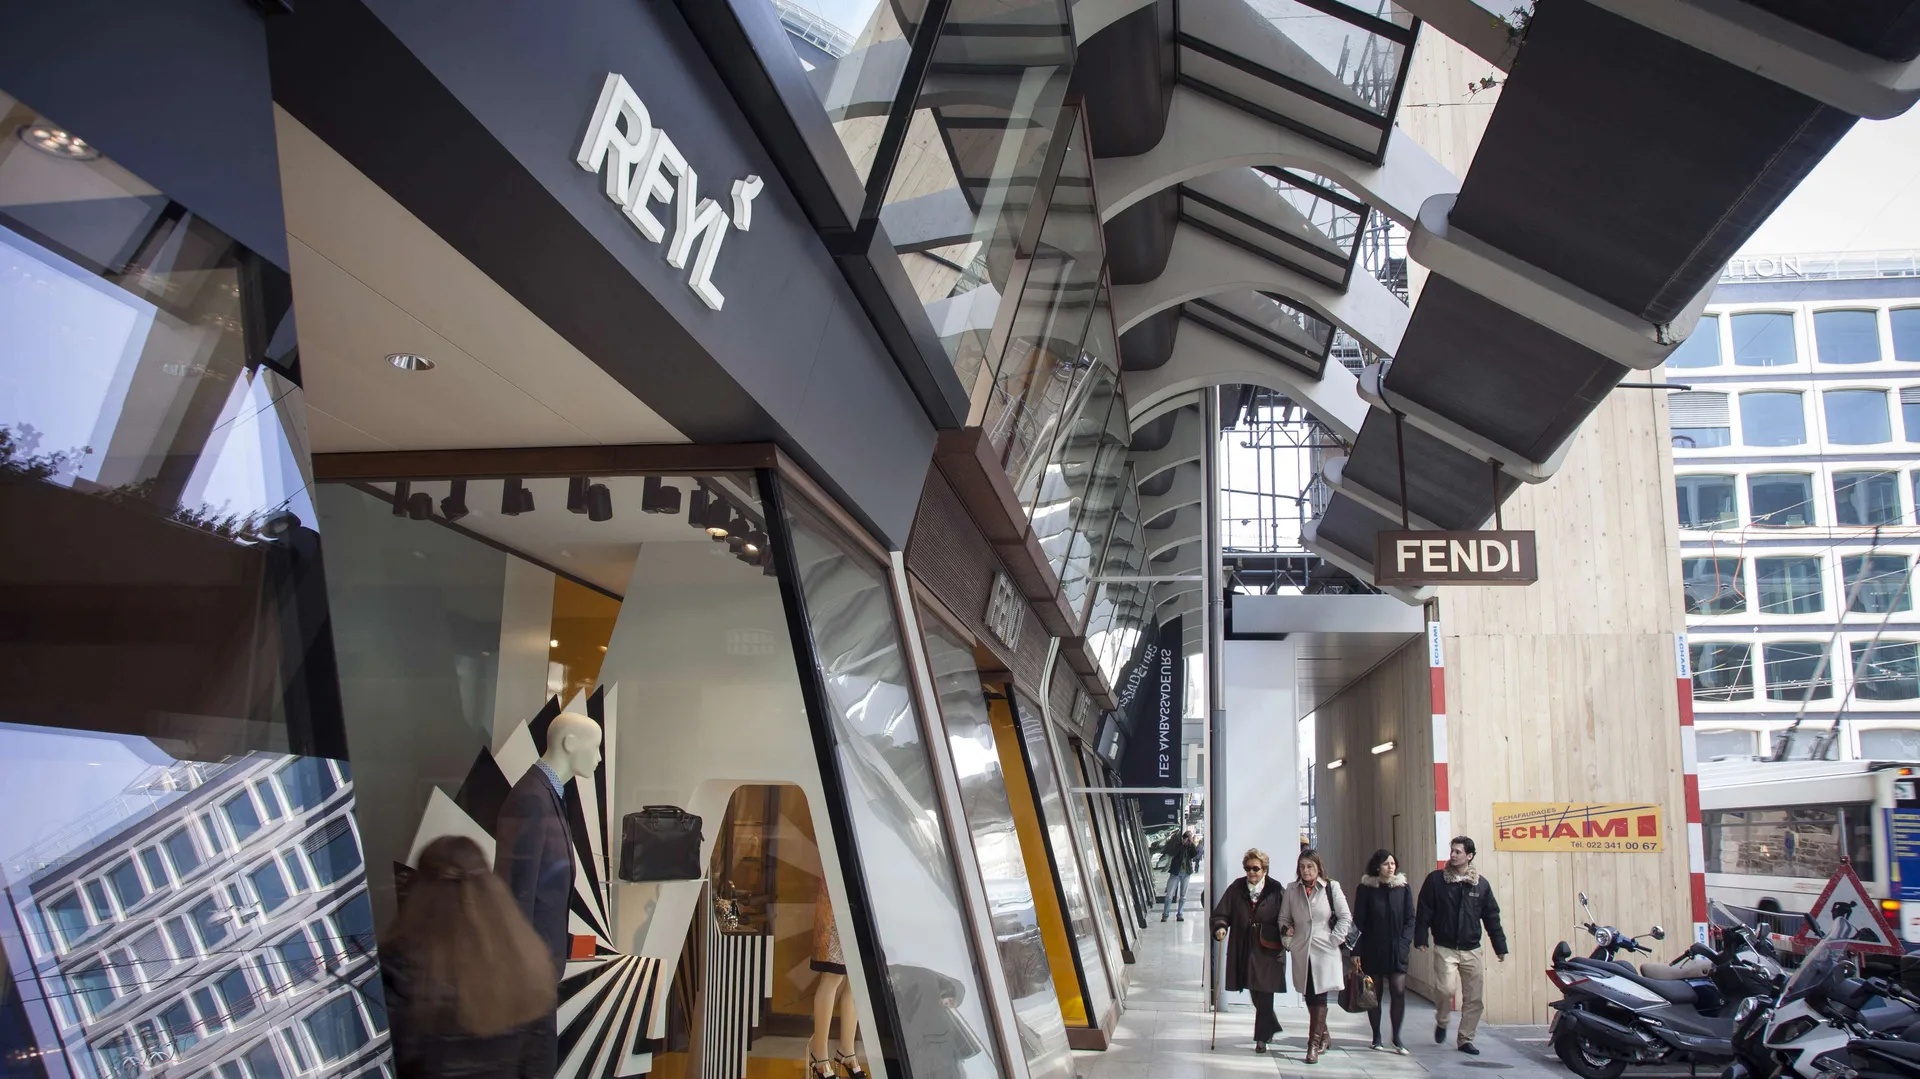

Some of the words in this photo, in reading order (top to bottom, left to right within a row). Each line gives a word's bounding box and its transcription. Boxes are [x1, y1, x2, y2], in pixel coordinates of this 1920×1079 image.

[577, 72, 730, 311] REYL
[1397, 540, 1520, 572] FENDI
[1498, 807, 1557, 821] ECHAFAUDAGES
[1500, 815, 1657, 839] ECHAMI
[1625, 842, 1639, 850] 00
[1642, 843, 1657, 851] 67
